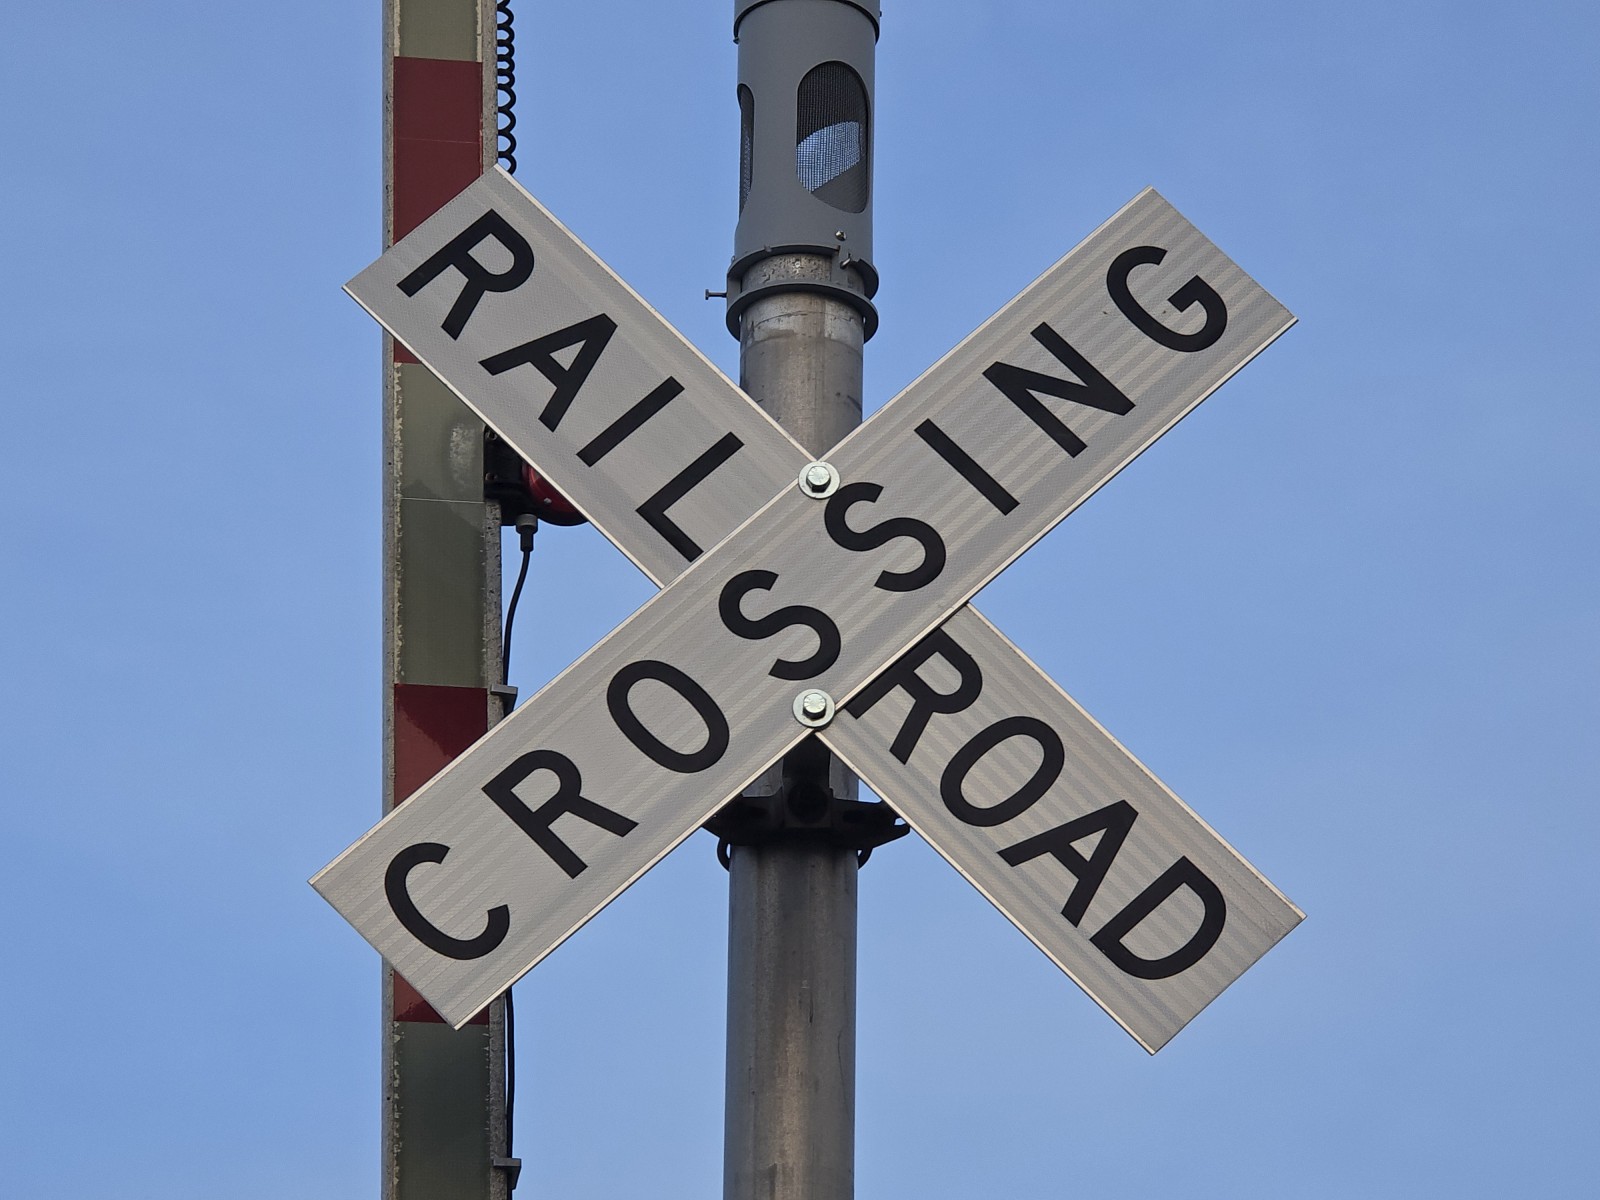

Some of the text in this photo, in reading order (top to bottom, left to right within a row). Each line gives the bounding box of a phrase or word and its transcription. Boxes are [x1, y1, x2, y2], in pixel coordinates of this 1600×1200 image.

[384, 245, 1227, 960] CROSSING
[396, 208, 1227, 980] RAIL ROAD
